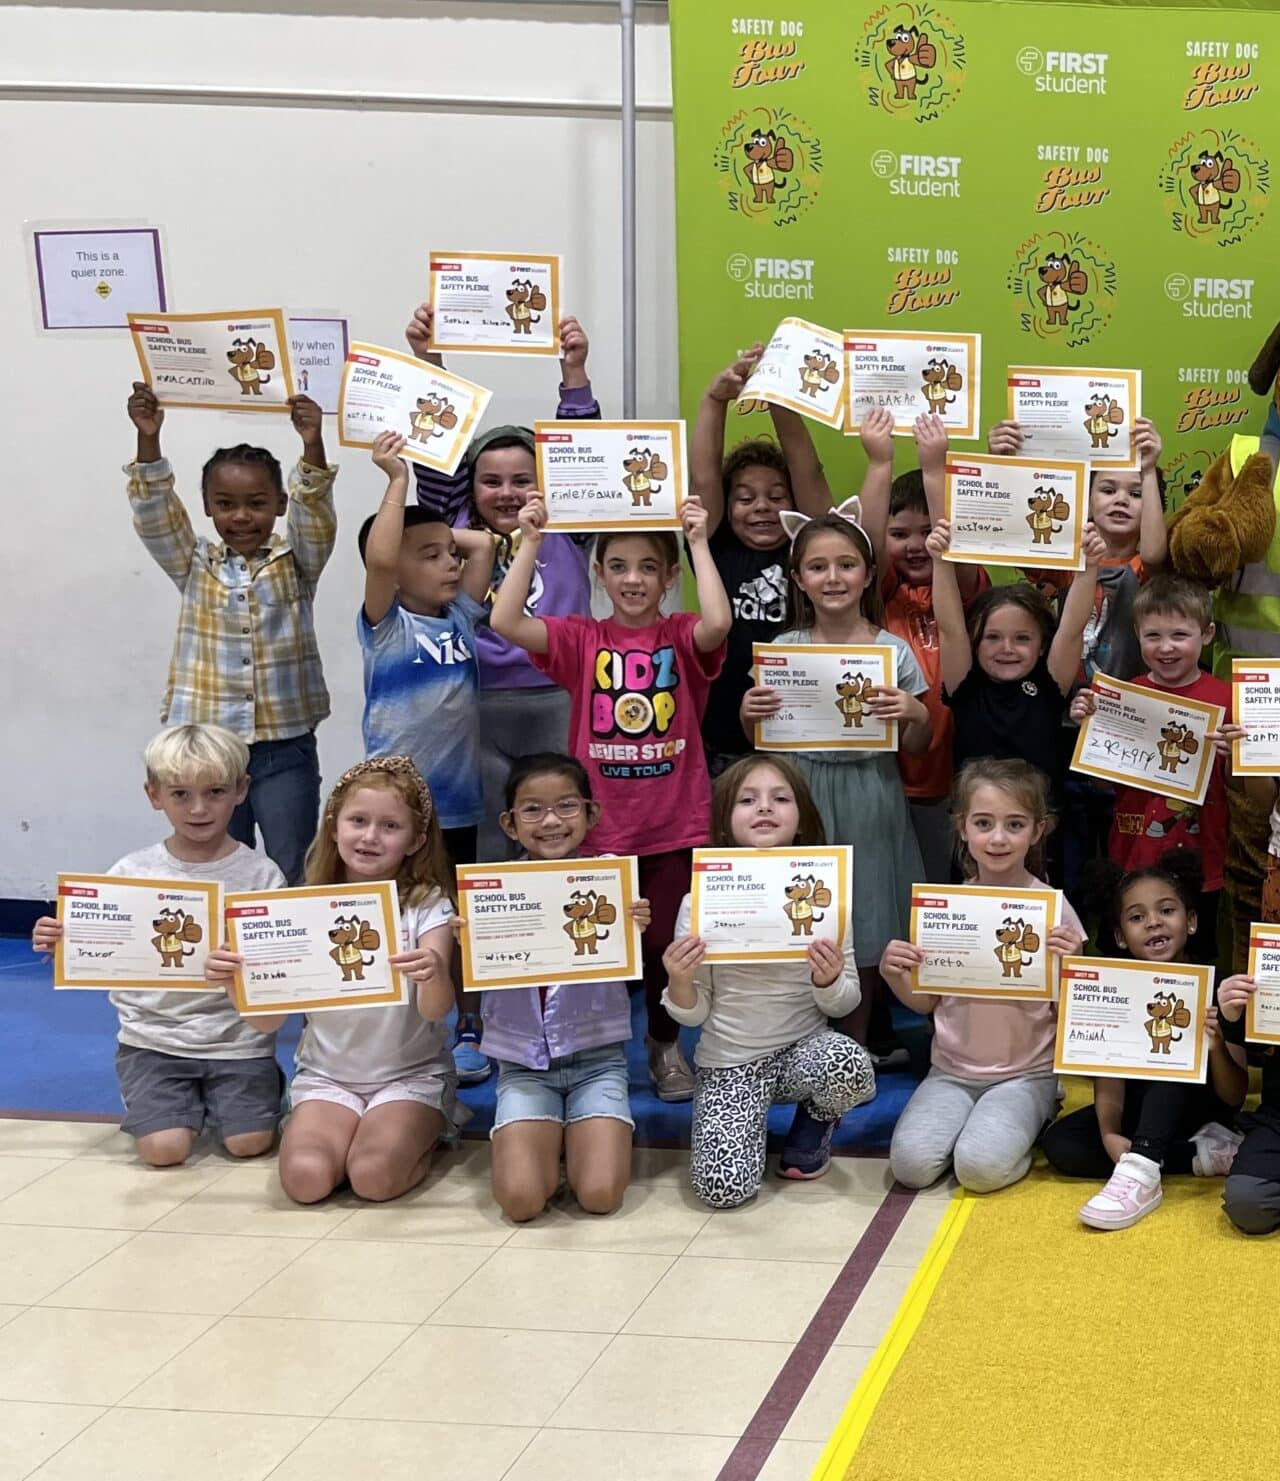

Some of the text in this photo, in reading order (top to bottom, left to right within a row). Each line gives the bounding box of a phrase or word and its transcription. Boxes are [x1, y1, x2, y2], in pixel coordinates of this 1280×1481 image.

[731, 18, 804, 36] SAFETY DOG
[738, 38, 797, 63] Bus
[1185, 41, 1259, 59] SAFETY DOG
[731, 58, 806, 89] Tour
[1046, 51, 1108, 74] FIRST
[1192, 60, 1251, 85] Bus
[1035, 73, 1107, 95] student
[1183, 80, 1259, 111] Tour
[900, 154, 962, 177] FIRST
[1037, 145, 1109, 164] SAFETY DOG
[890, 176, 960, 198] student
[1043, 164, 1103, 190] Bus
[1035, 183, 1110, 214] Tour
[76, 251, 119, 261] This is a
[888, 247, 959, 265] SAFETY DOG
[71, 267, 127, 280] quiet zone.
[754, 257, 814, 281] FIRST
[893, 267, 951, 291] Bus
[744, 278, 814, 300] student
[886, 285, 960, 315] Tour
[1193, 278, 1254, 300] FIRST
[1182, 298, 1253, 319] student
[306, 340, 335, 351] when
[1178, 368, 1248, 384] SAFETY DOG
[1184, 386, 1241, 410] Bus
[1176, 404, 1250, 433] Tour
[595, 646, 679, 690] KIDZ
[1245, 696, 1272, 704] SAFETY
[589, 738, 686, 761] NEVER STOP
[602, 763, 672, 777] LIVE TOUR
[474, 894, 506, 902] SCHOOL
[475, 902, 542, 913] SAFETY PLEDGE
[242, 919, 291, 929] SCHOOL BUS
[243, 928, 308, 940] SAFETY PLEDGE
[1073, 984, 1101, 992] SCHOOL
[1073, 994, 1129, 1004] SAFETY PLEDGE
